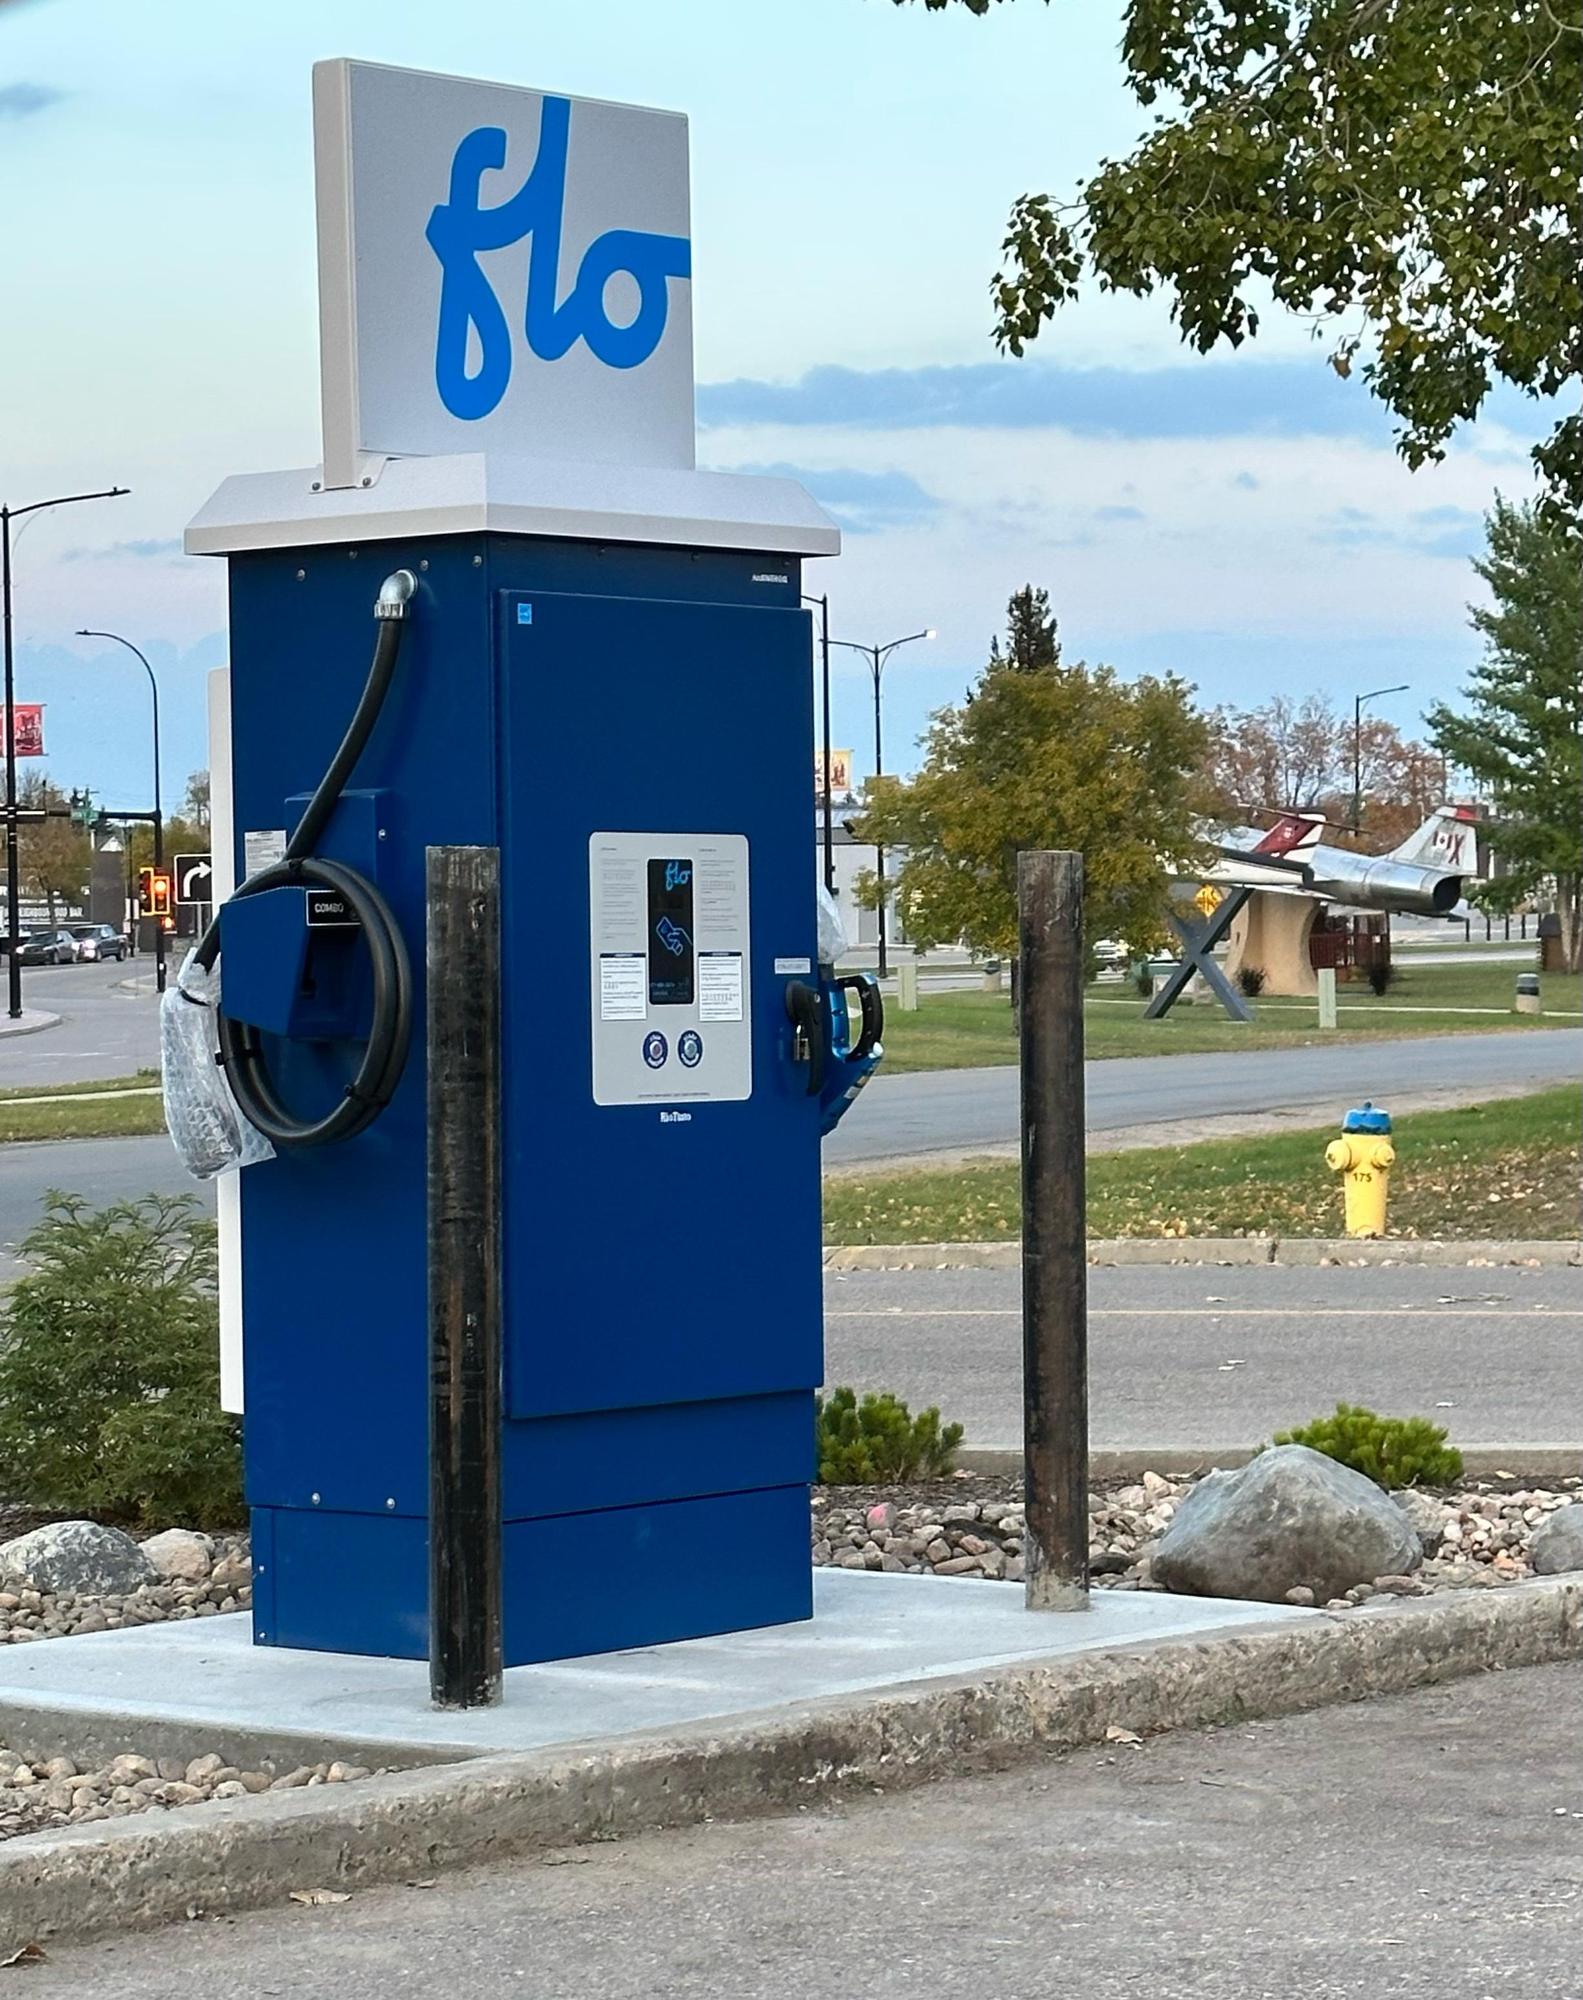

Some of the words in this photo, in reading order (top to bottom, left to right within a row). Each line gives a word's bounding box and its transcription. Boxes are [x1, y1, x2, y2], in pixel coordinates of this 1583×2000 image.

[425, 95, 691, 421] flo
[665, 860, 691, 891] flo
[314, 903, 344, 913] COMBO
[1353, 1172, 1372, 1183] 175
